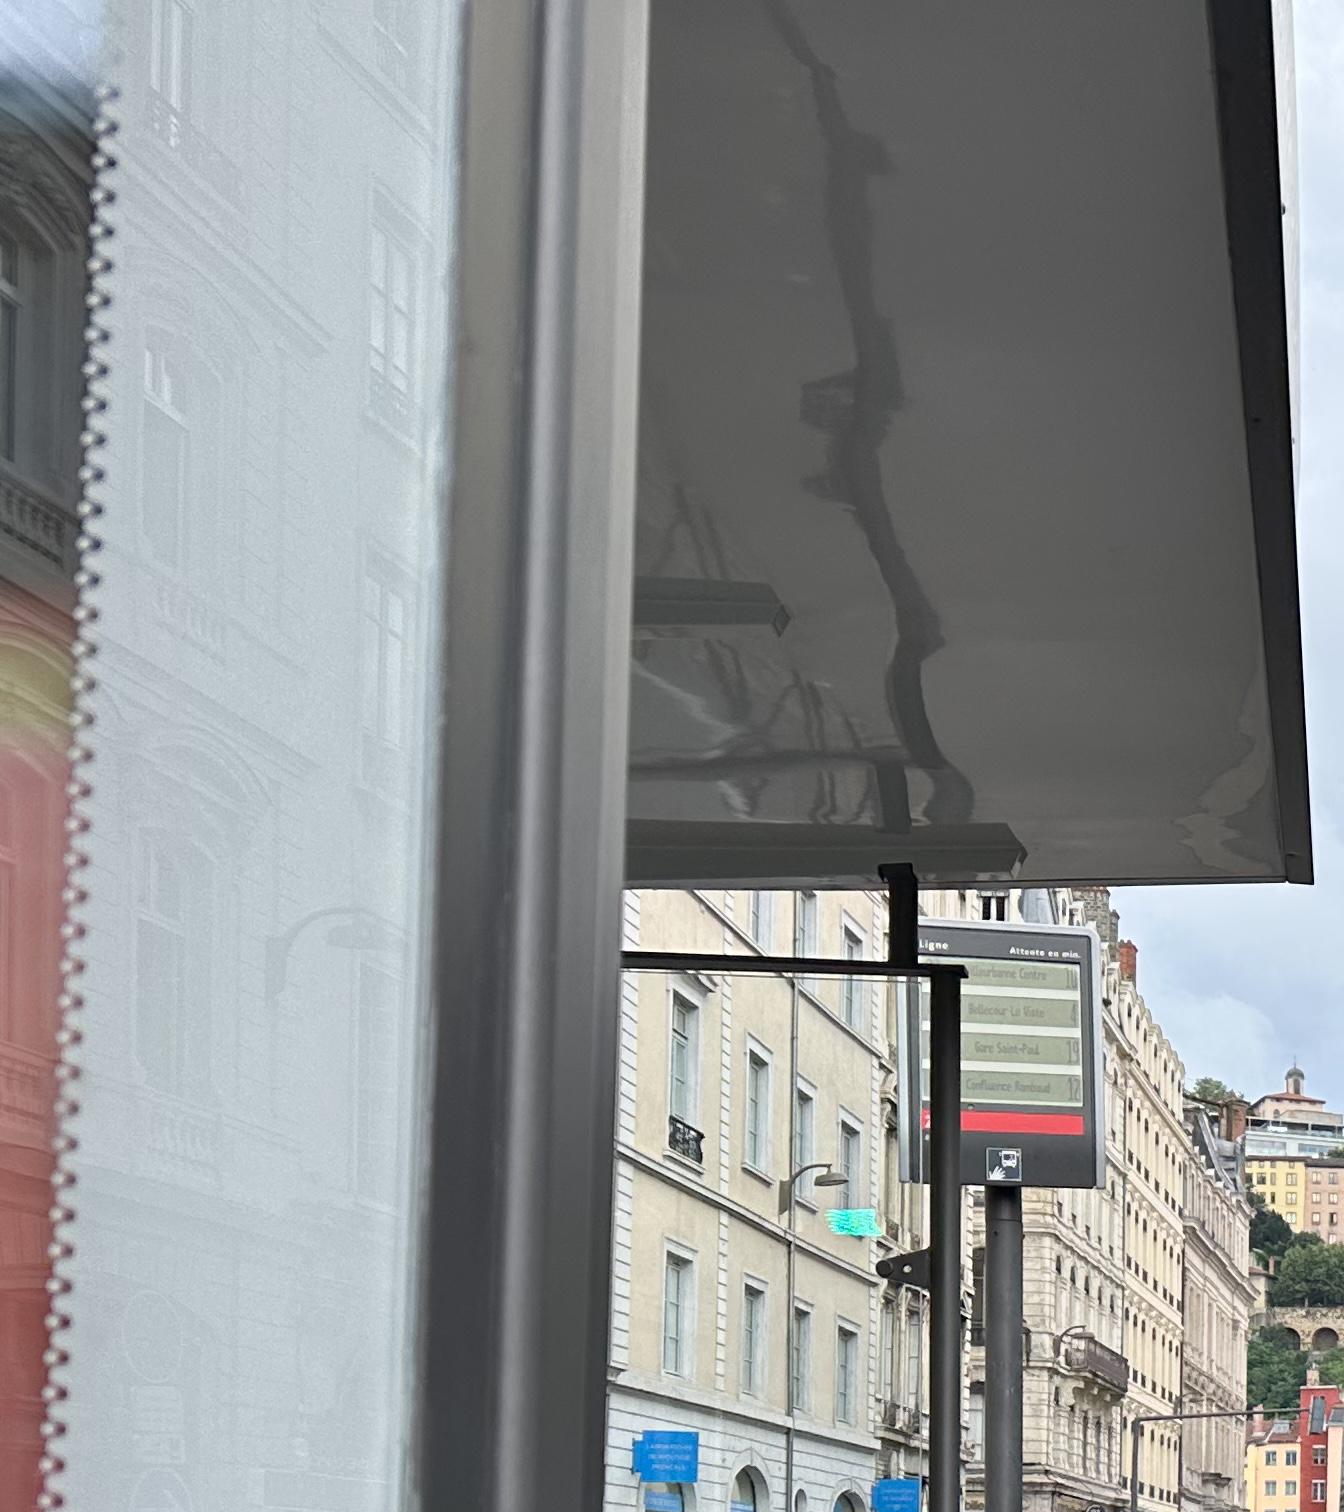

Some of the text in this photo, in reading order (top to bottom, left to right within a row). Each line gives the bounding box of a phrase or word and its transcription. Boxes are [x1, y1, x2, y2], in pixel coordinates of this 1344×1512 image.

[918, 938, 949, 951] Ligne
[1009, 946, 1081, 959] Attente en min.
